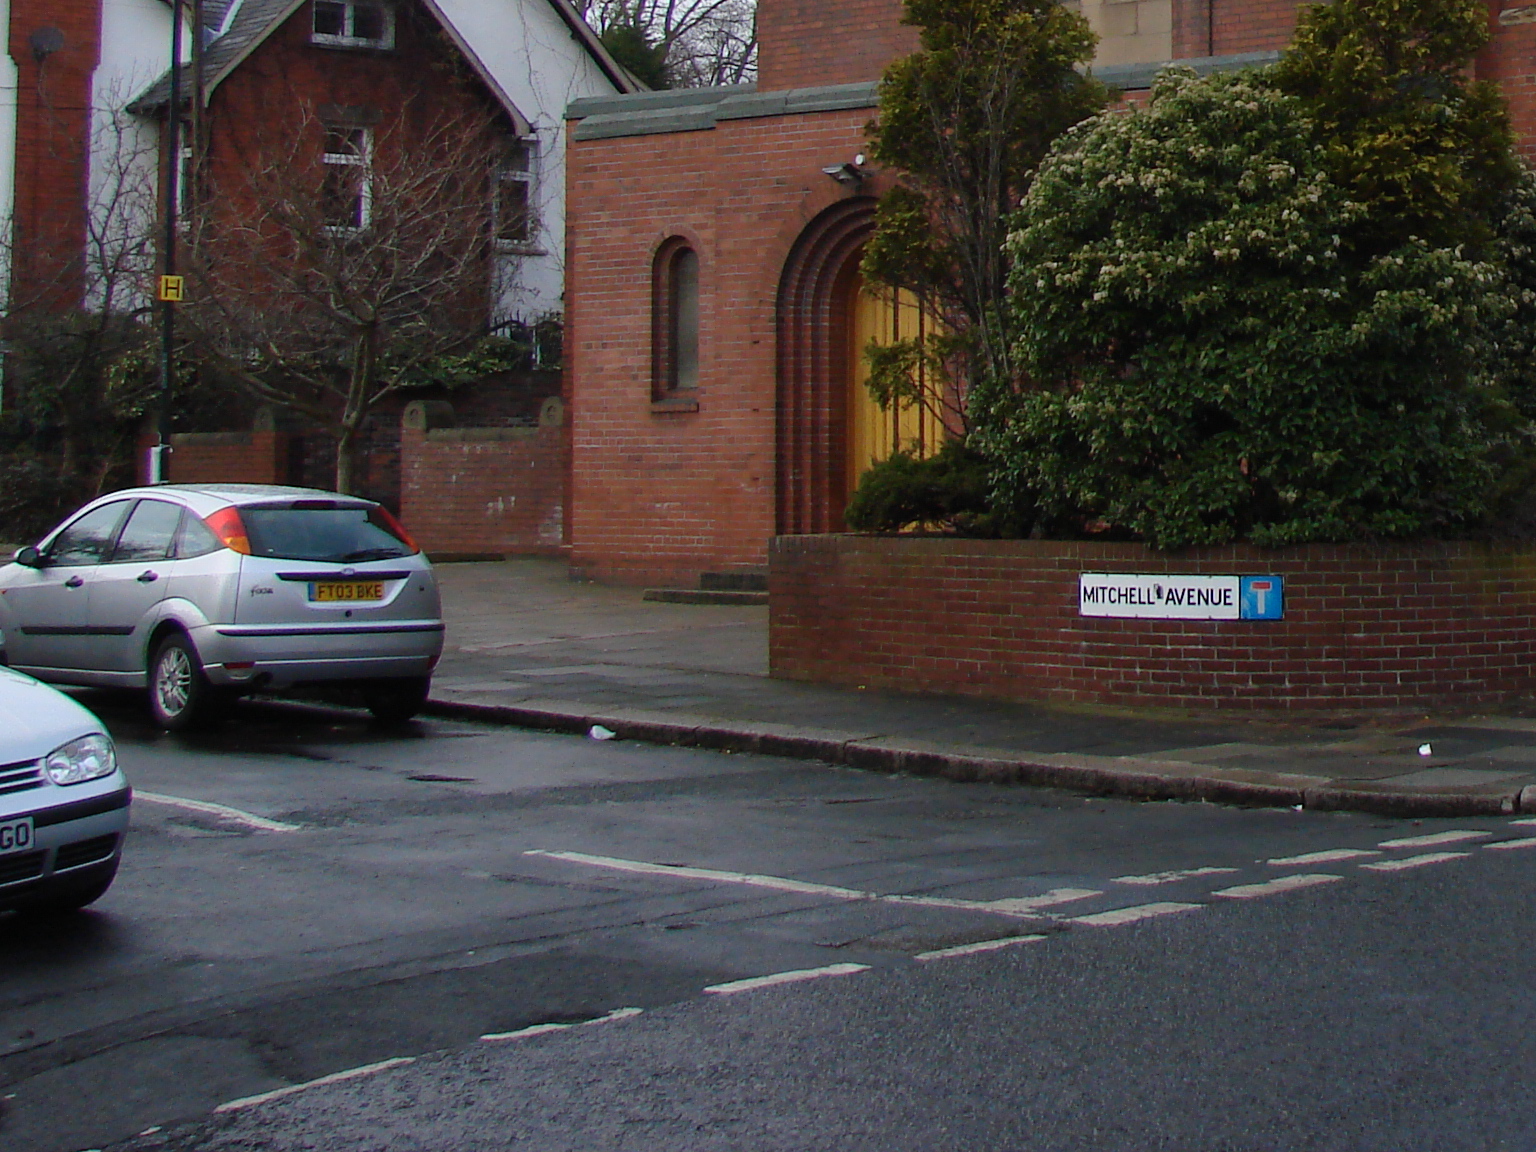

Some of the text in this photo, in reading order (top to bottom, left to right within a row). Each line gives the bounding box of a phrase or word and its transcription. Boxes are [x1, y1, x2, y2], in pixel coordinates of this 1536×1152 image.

[165, 278, 180, 298] H
[318, 584, 383, 599] FT03 BKE
[1083, 586, 1233, 606] MITCHELL AVENUE
